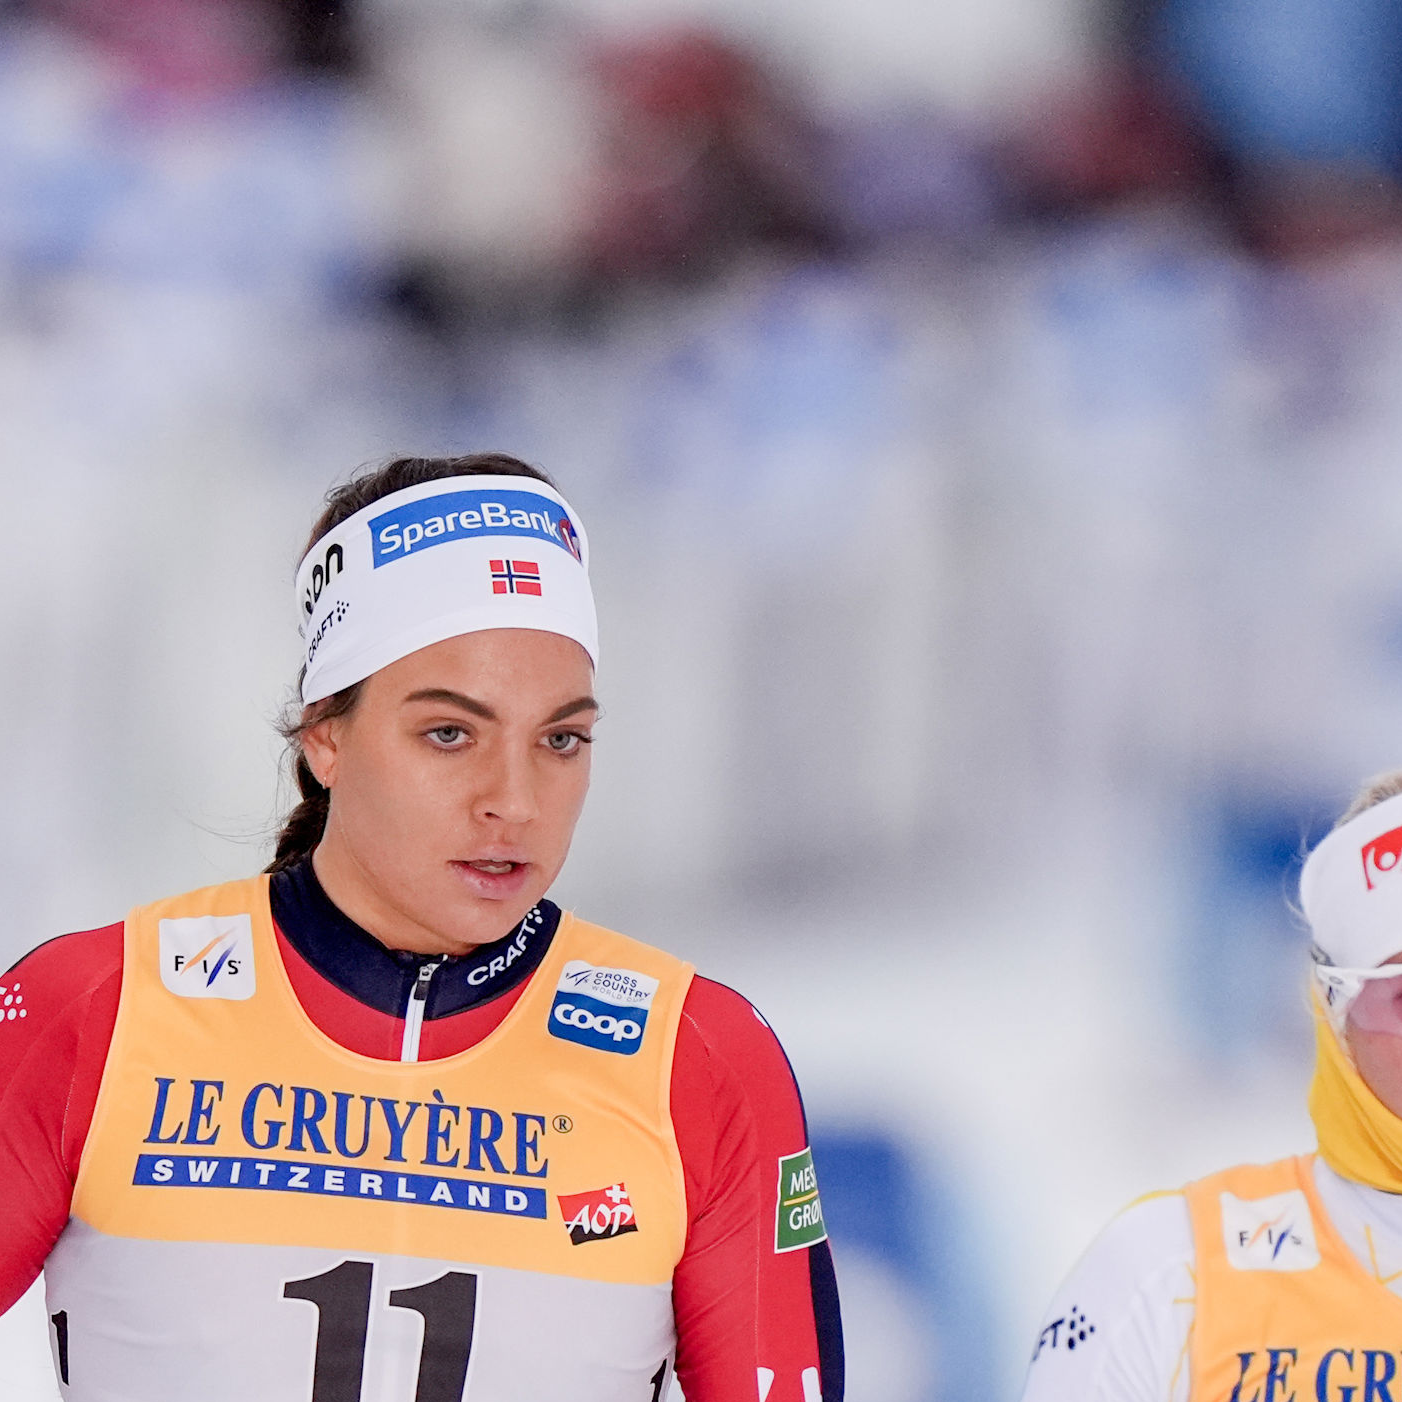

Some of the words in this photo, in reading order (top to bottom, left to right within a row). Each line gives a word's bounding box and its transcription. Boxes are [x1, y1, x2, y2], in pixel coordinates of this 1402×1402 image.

[379, 502, 562, 556] SpareBank
[308, 610, 334, 663] CRAFT
[466, 917, 536, 986] CRAFT
[593, 978, 651, 999] COUNTRY
[595, 972, 638, 989] CROSS
[553, 1003, 642, 1042] coop
[142, 1077, 224, 1146] LE
[151, 1159, 530, 1213] SWITZERLAND
[564, 1203, 634, 1237] AOP
